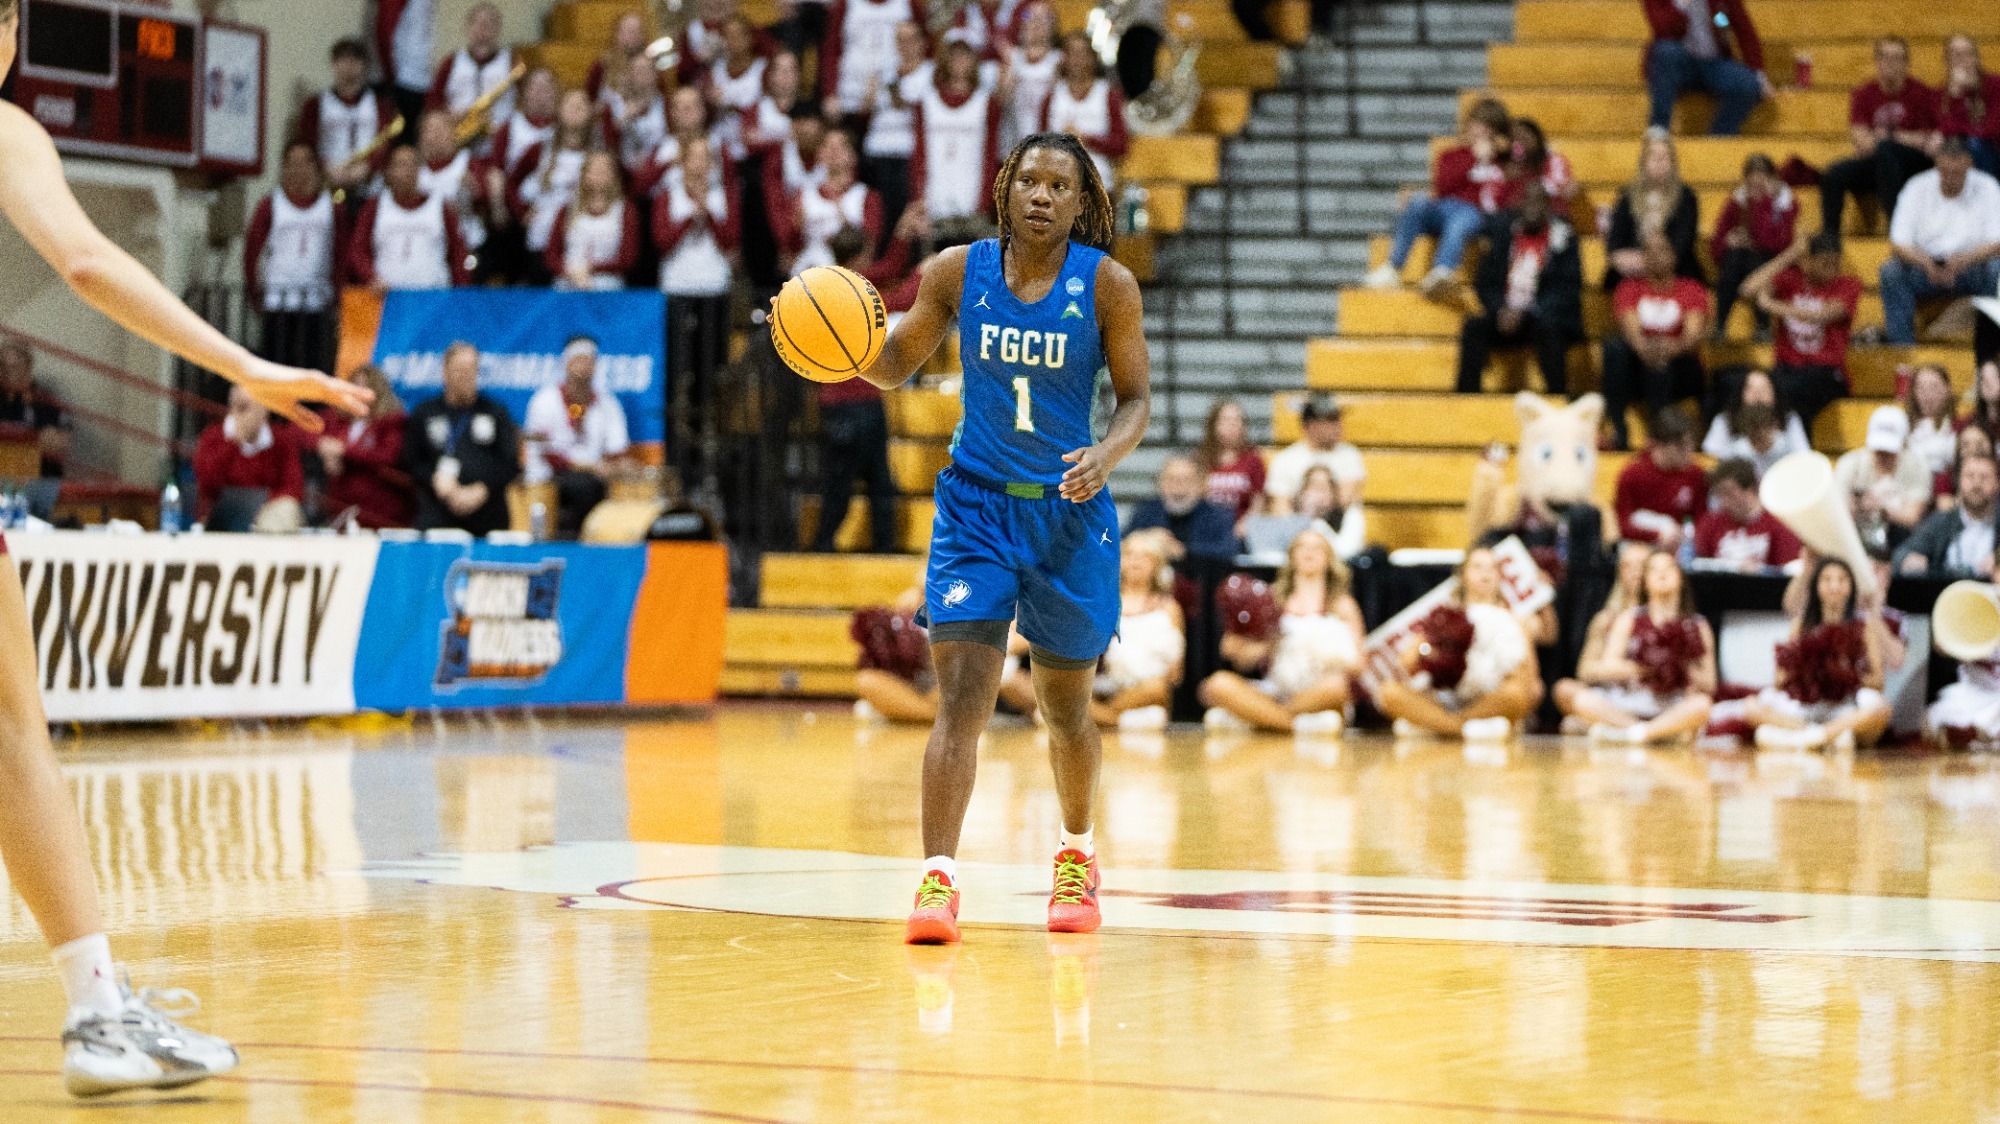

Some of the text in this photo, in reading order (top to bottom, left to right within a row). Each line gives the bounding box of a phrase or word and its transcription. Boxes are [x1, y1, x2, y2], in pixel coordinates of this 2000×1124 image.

[979, 322, 1069, 370] FGCU
[1012, 375, 1035, 433] 1
[19, 558, 340, 691] UNIVERSITY
